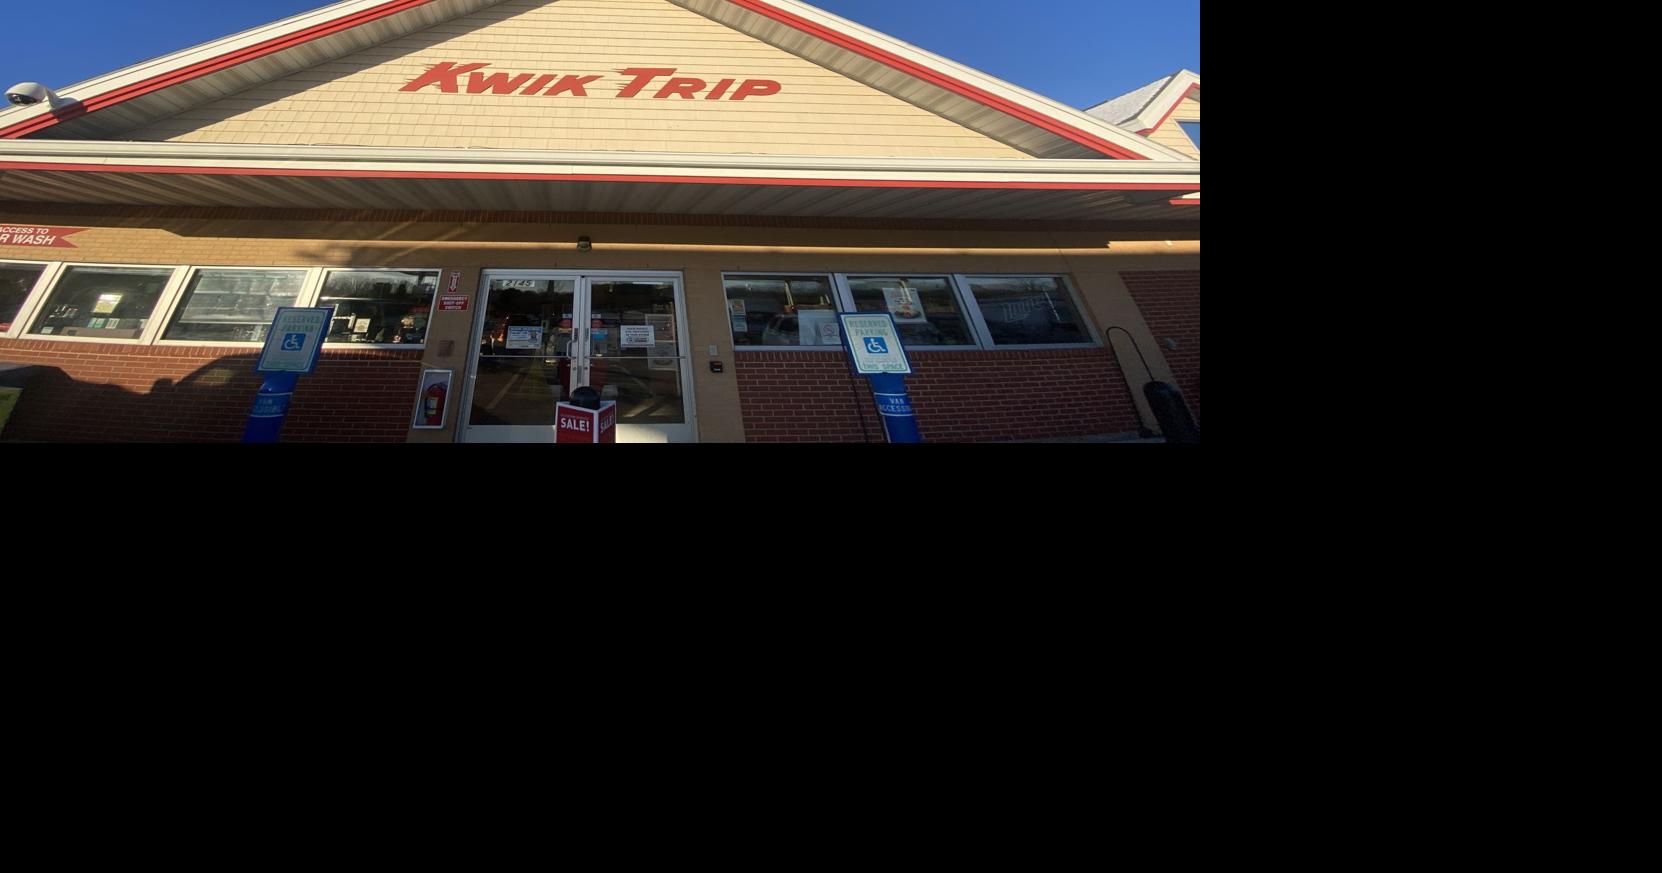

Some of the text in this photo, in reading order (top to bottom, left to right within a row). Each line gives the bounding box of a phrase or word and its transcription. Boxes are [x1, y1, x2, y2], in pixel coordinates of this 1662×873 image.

[399, 62, 782, 100] KWIK TRIP
[12, 234, 56, 245] WASH
[889, 397, 905, 405] VAN
[560, 417, 590, 432] SALE!
